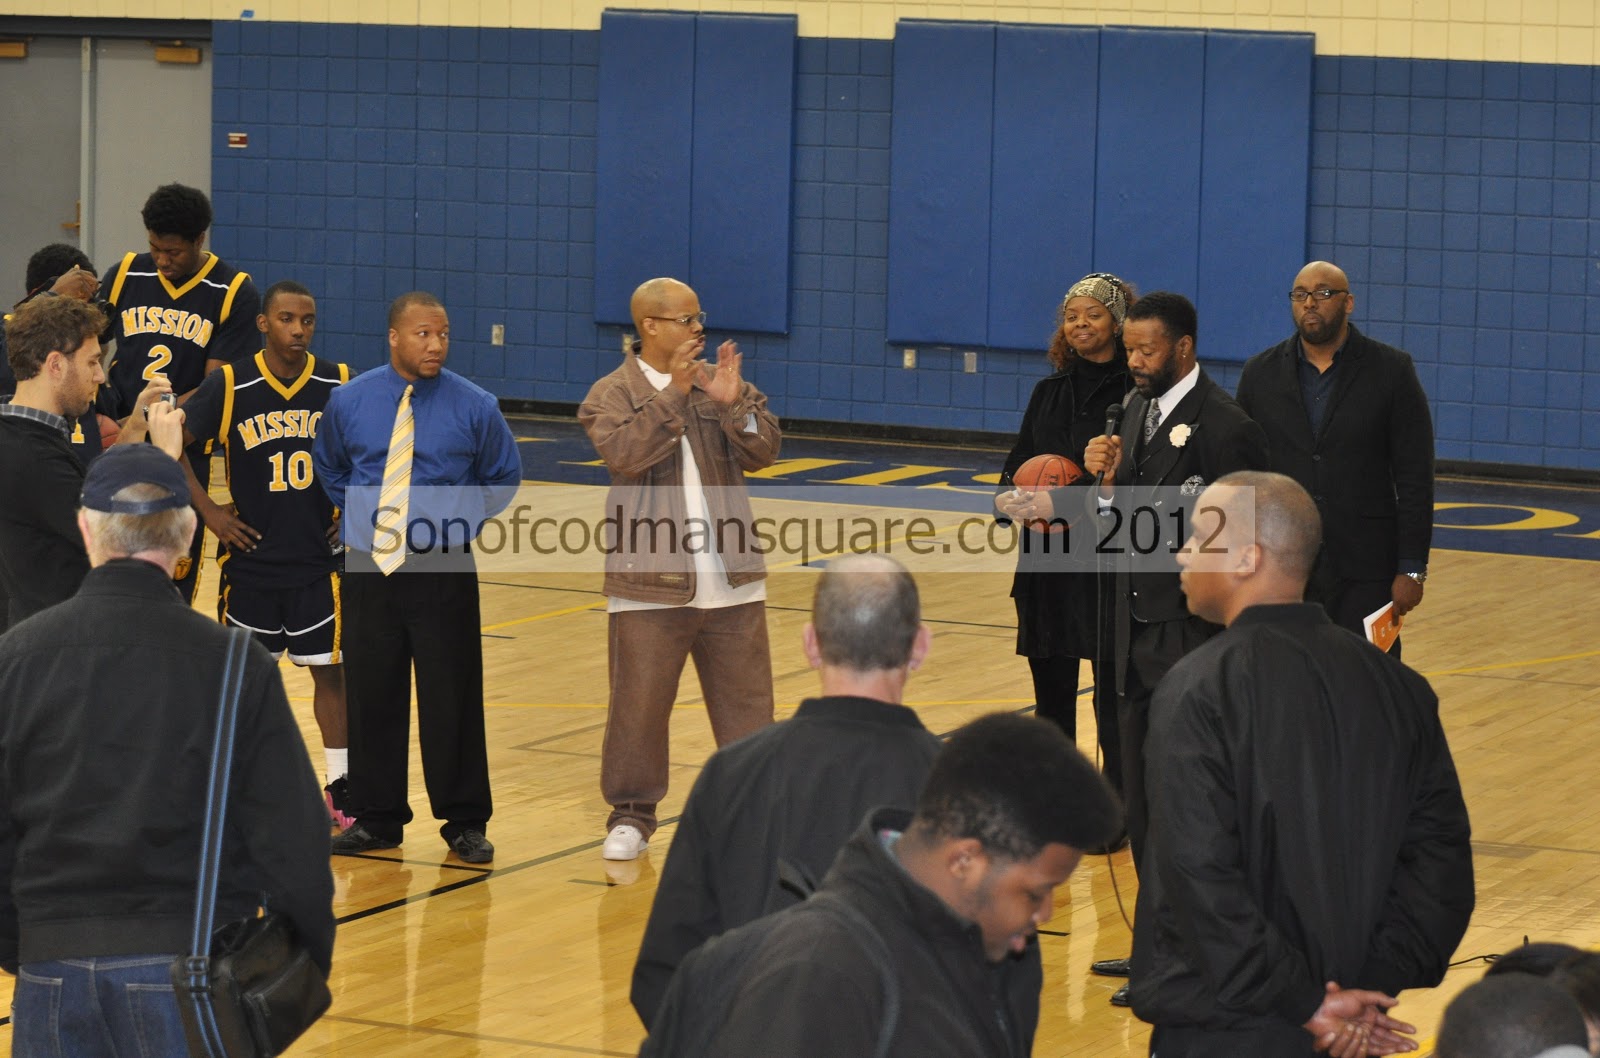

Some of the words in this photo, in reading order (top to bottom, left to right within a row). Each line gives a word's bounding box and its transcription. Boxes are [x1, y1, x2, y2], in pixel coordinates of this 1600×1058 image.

[121, 306, 214, 348] MISSION
[142, 344, 173, 381] 2
[268, 450, 314, 492] 10
